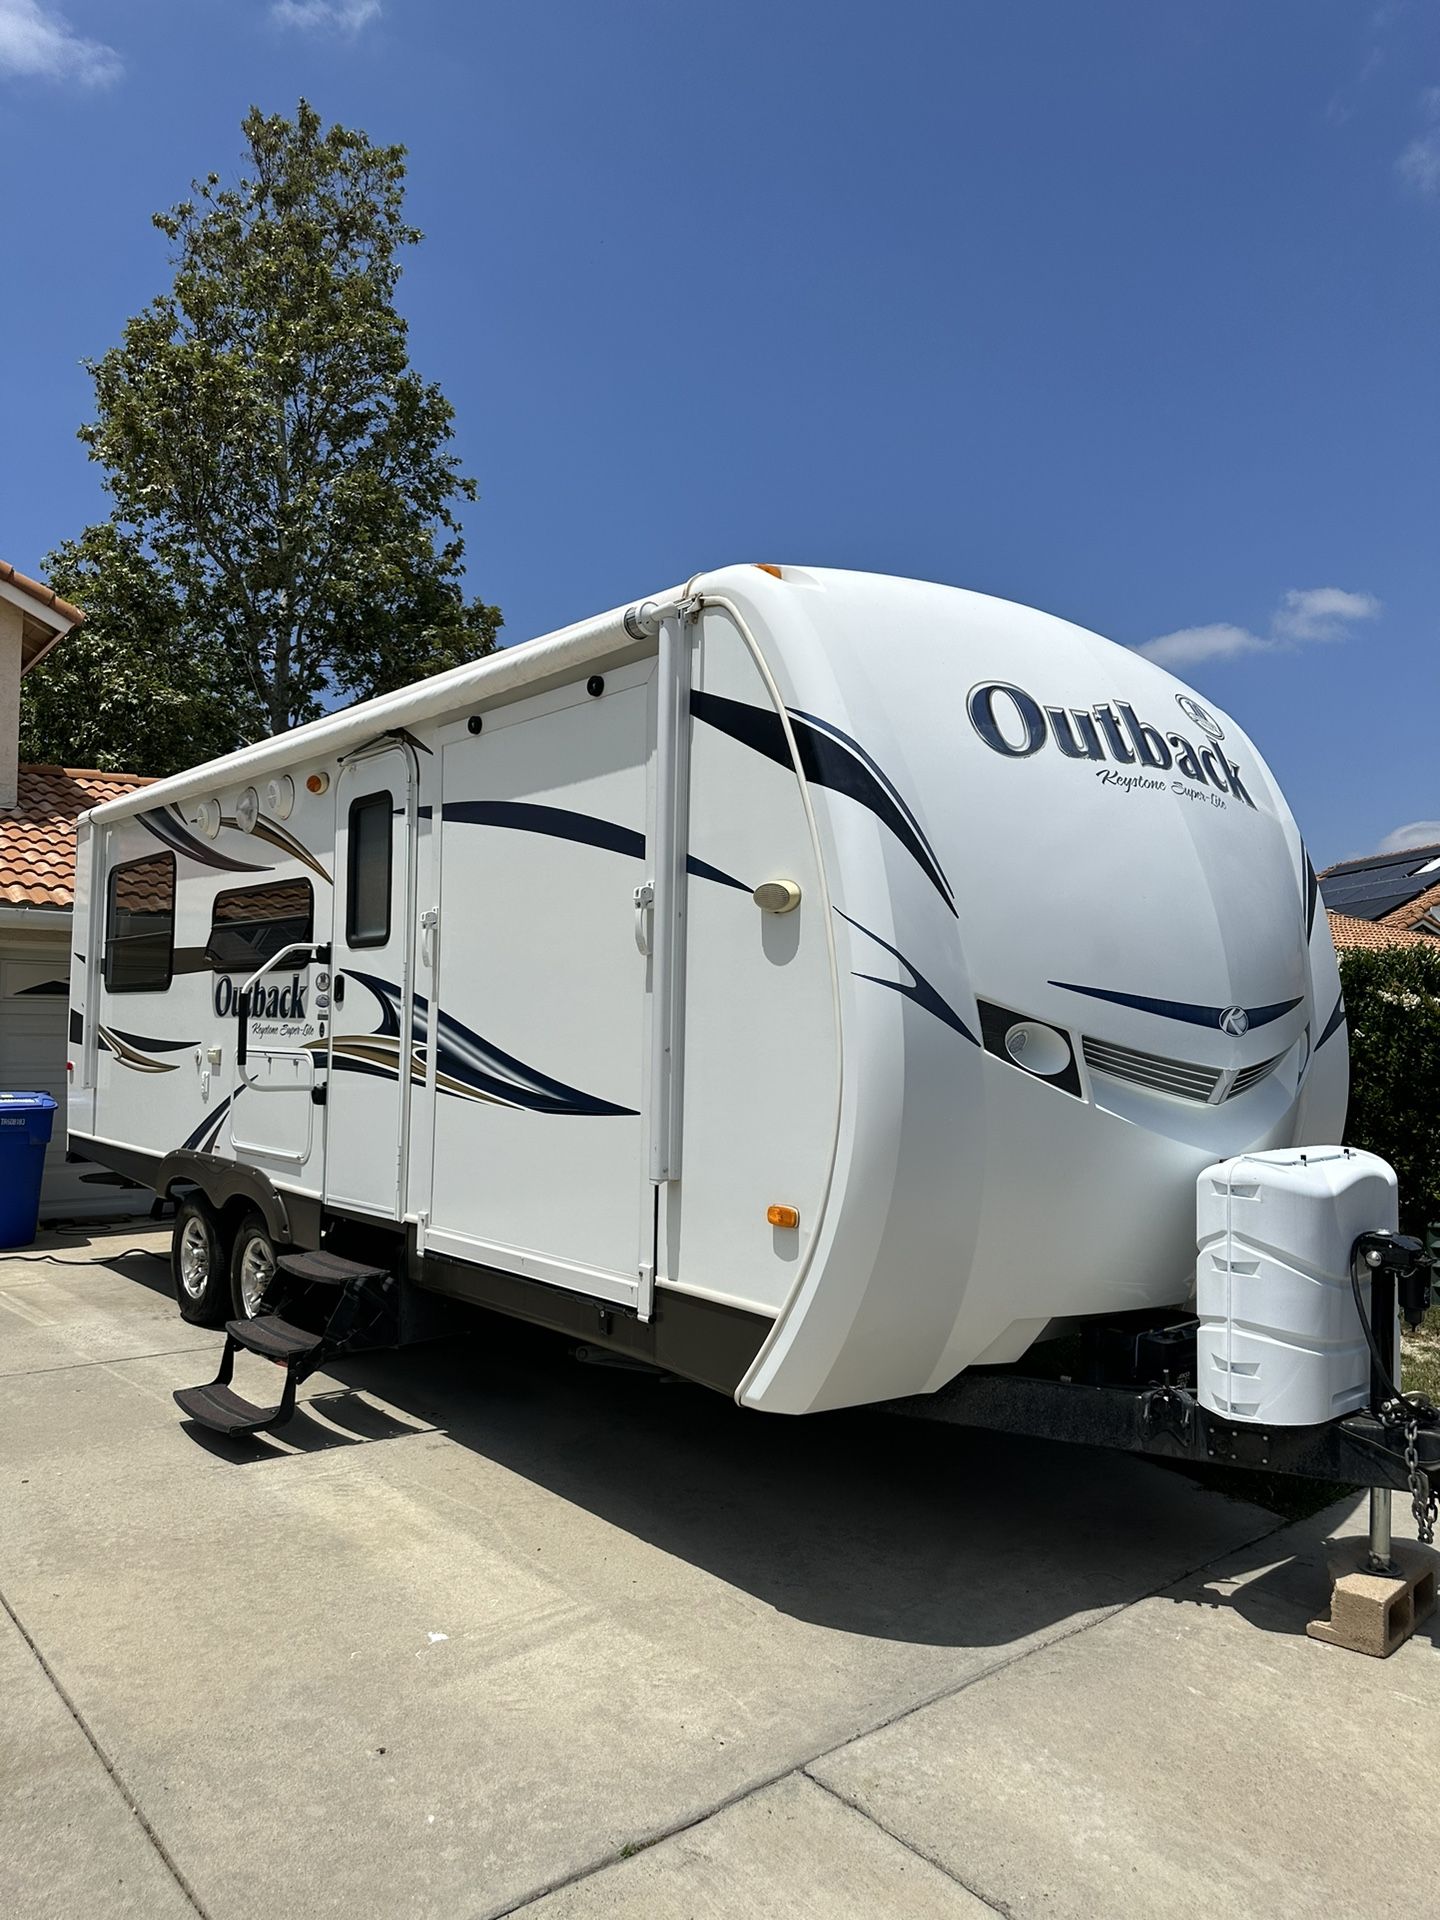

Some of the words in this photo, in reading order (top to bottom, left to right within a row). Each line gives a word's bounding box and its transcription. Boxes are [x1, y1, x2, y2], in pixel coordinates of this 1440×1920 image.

[966, 680, 1258, 811] Outback
[1096, 769, 1166, 792] Keystone
[1171, 781, 1227, 809] Super-Lite
[215, 974, 308, 1019] Ouback
